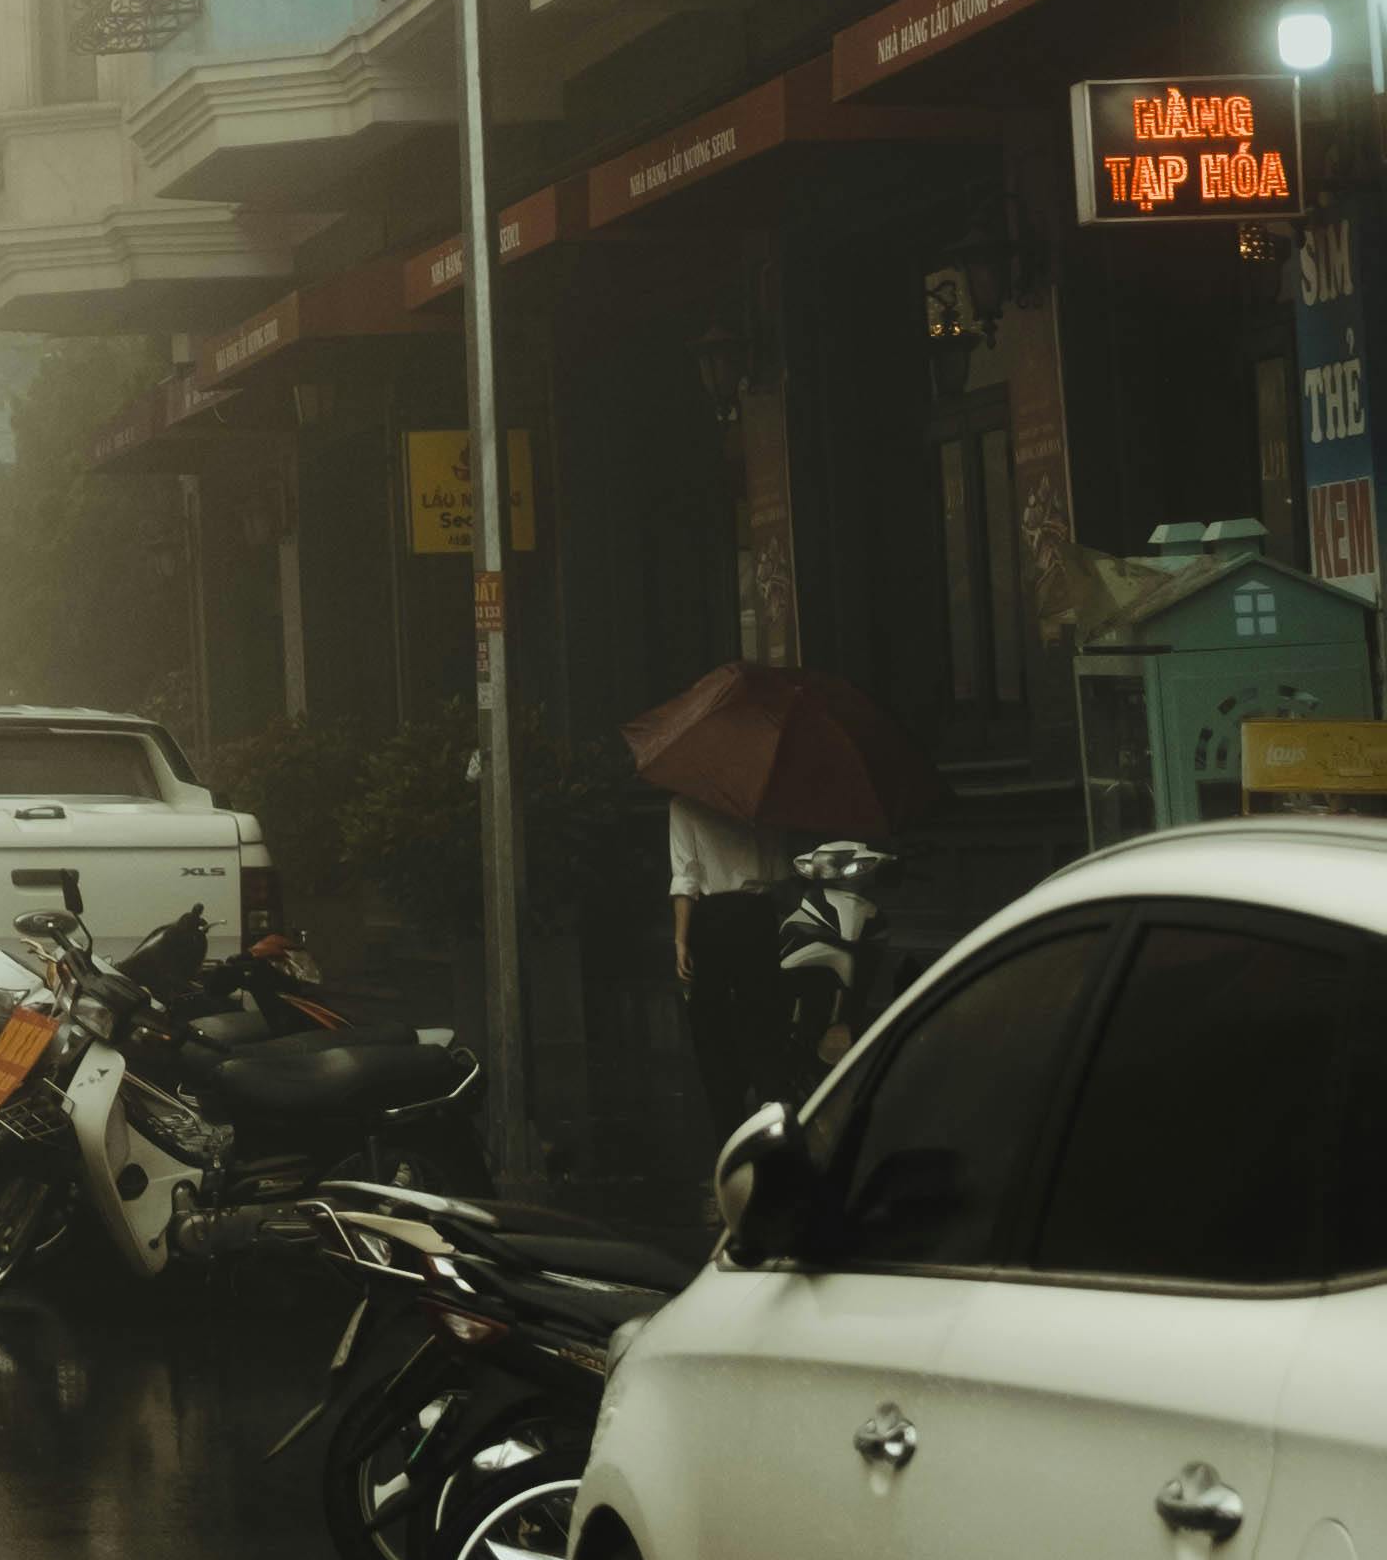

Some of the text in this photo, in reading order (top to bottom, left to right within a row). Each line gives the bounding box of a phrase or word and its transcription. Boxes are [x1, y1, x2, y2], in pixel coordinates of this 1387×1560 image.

[901, 17, 928, 54] HÀNG
[1133, 87, 1254, 140] HÀNG
[1104, 142, 1290, 212] TẠP HÓA
[1299, 220, 1354, 306] SIM
[1304, 327, 1365, 443] THẺ
[1310, 480, 1378, 579] KEM
[179, 867, 227, 877] XLS
